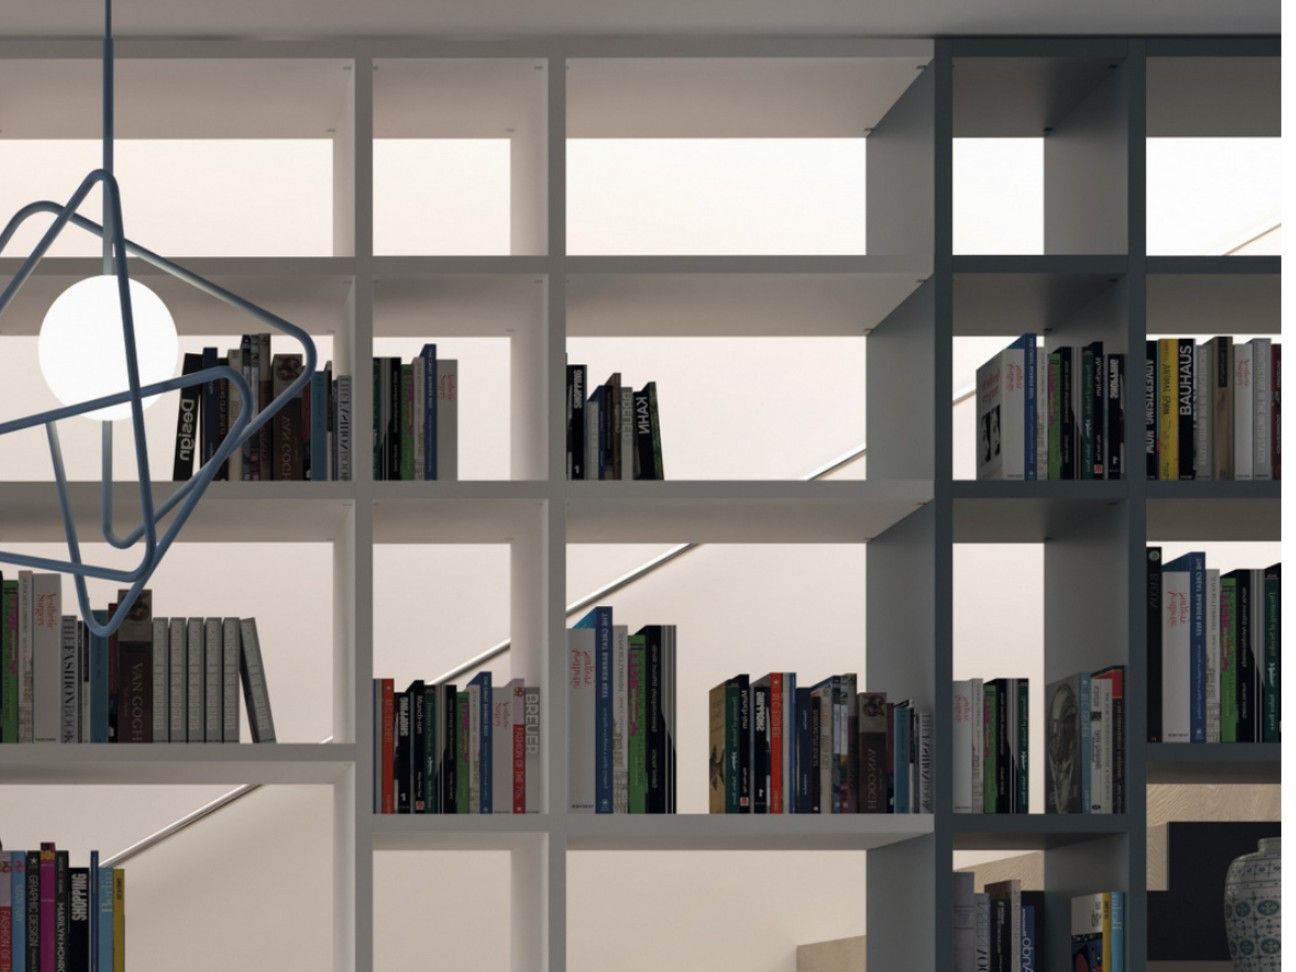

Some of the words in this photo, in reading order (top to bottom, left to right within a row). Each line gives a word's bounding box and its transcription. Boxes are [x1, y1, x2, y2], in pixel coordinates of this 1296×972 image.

[1179, 345, 1191, 416] BAUHAUS
[64, 645, 75, 703] FASHION
[132, 663, 143, 692] VAN
[526, 694, 538, 754] BREUER
[72, 873, 87, 921] SHOPPING
